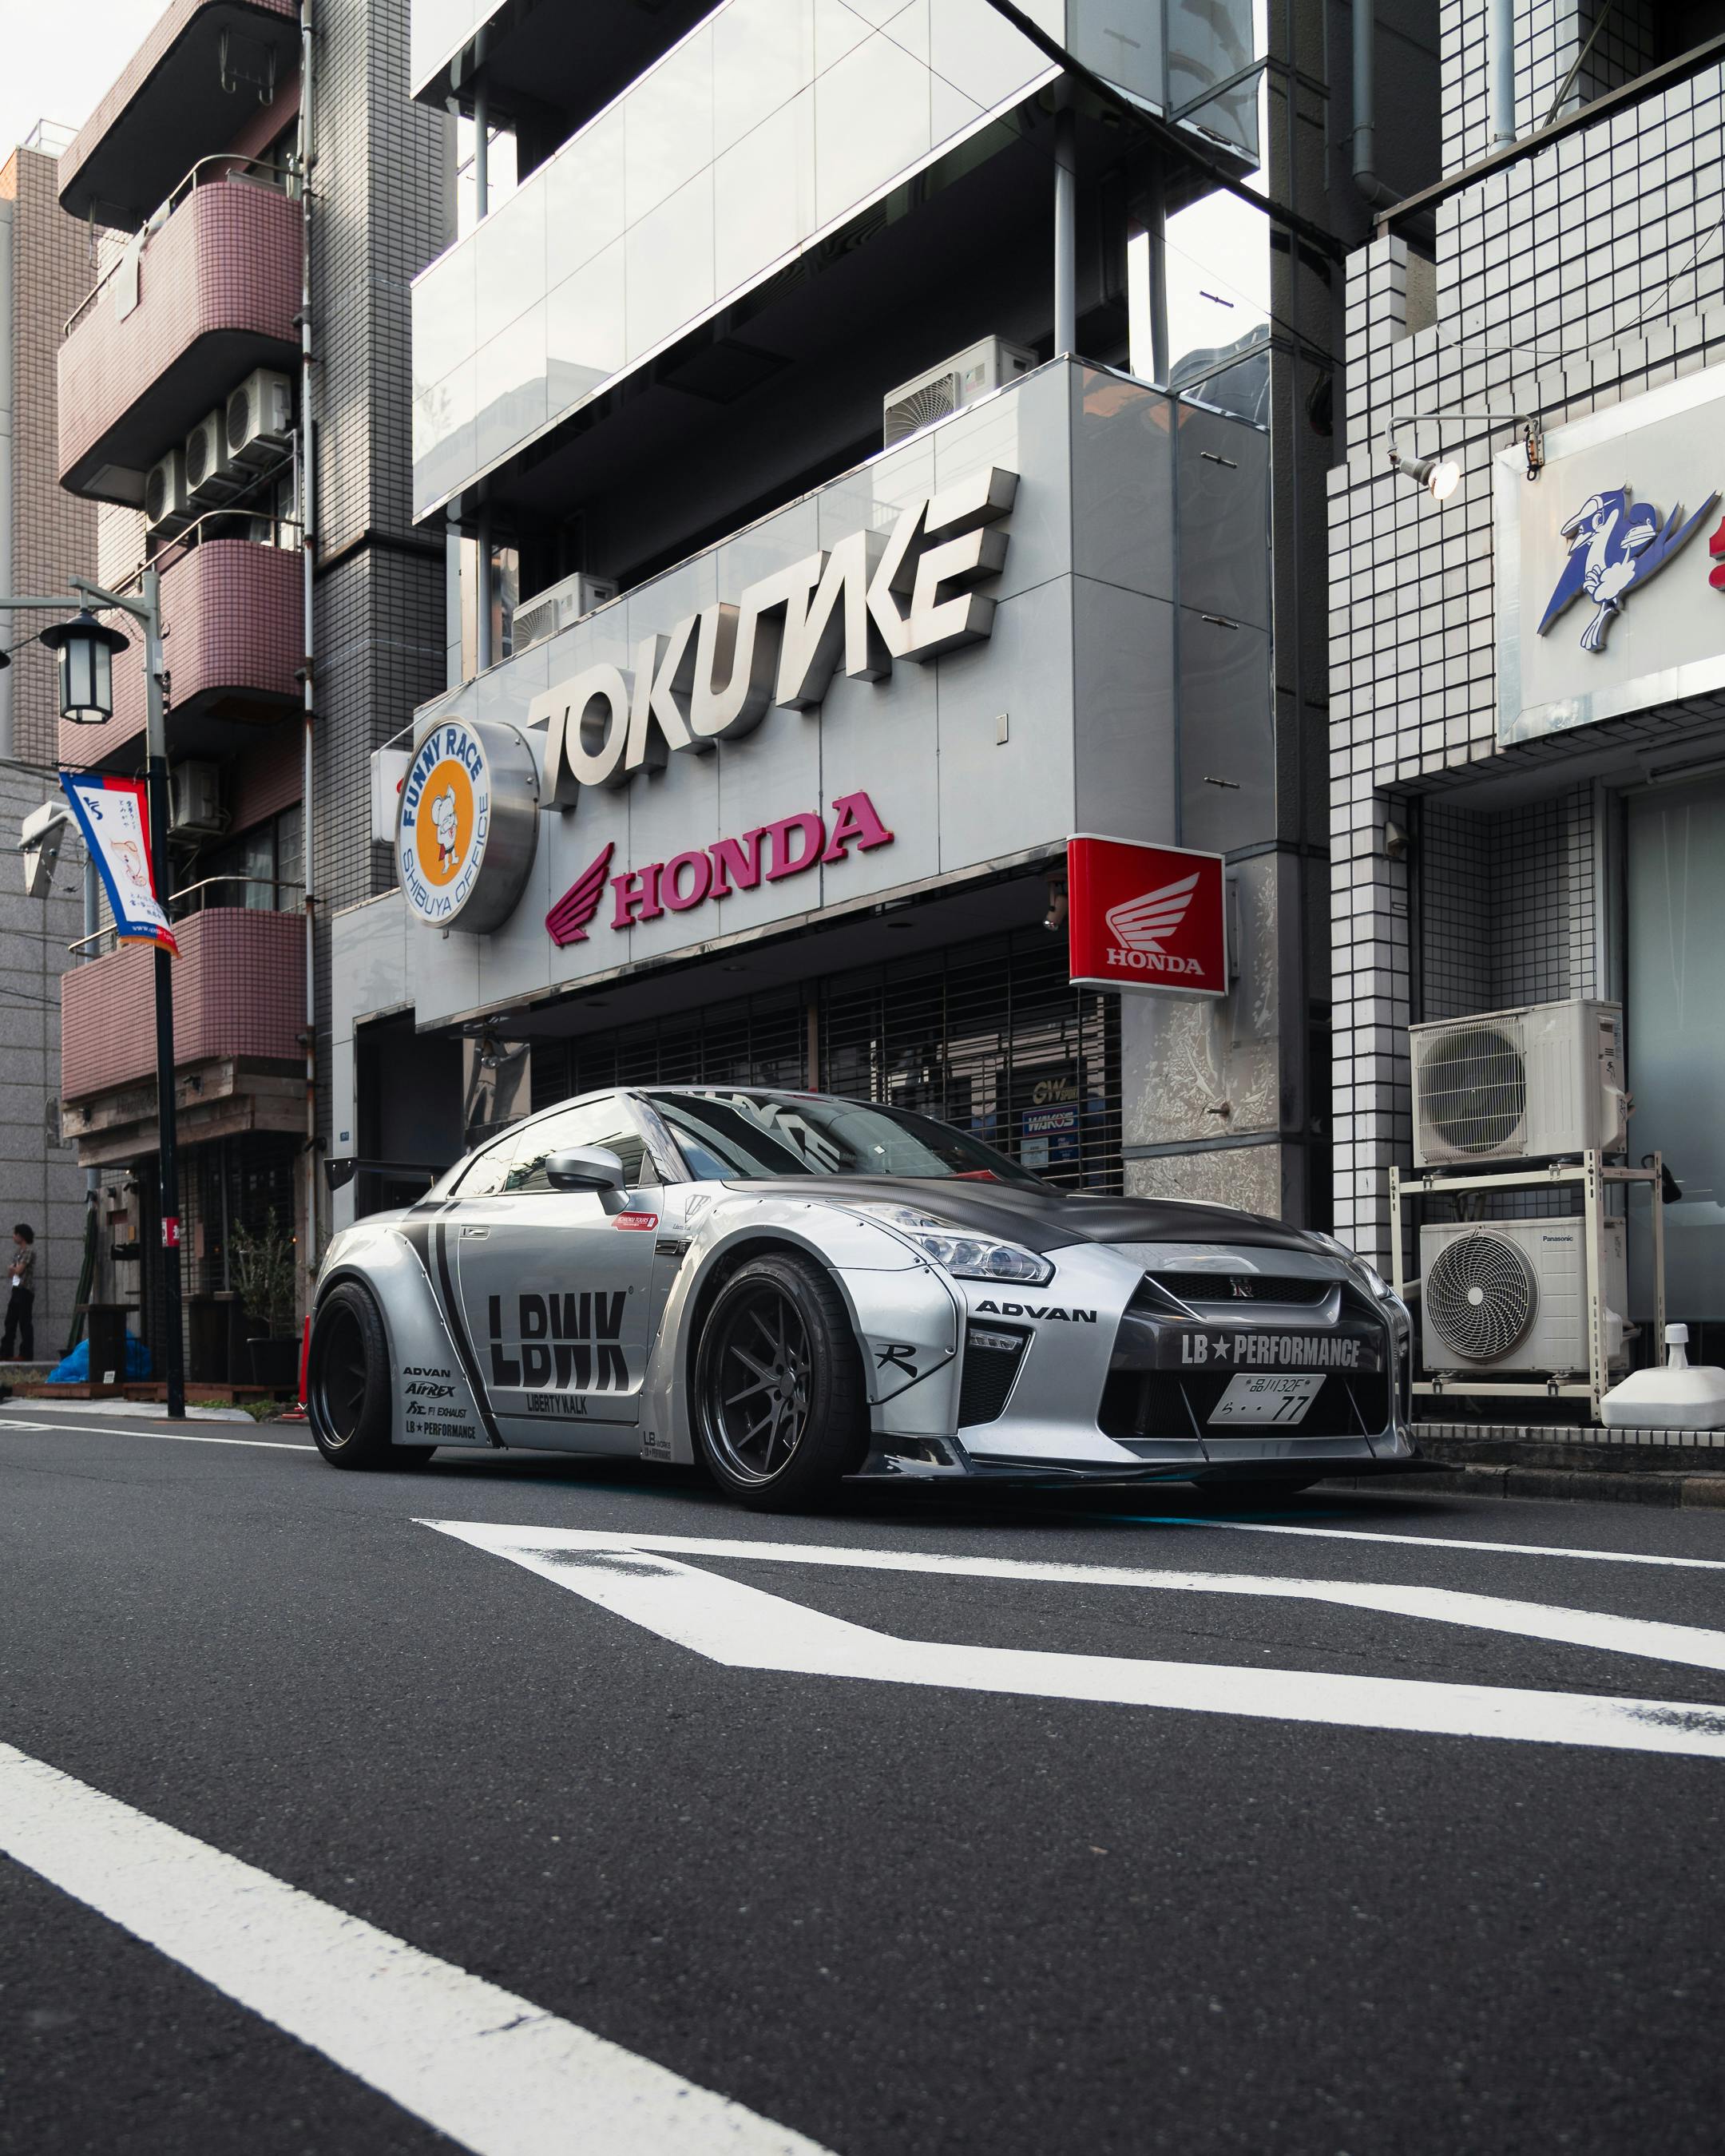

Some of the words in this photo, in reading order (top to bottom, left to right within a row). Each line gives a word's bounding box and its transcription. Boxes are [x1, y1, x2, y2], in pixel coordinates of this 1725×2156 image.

[403, 734, 442, 827] FUNNY
[446, 728, 483, 783] RACE
[403, 848, 452, 917] SHIBUYA
[455, 792, 488, 903] OFFICE
[610, 791, 894, 929] HONDA
[1106, 948, 1205, 975] HONDA
[975, 1300, 1097, 1323] ADVAN
[1182, 1334, 1208, 1364] LB
[1233, 1334, 1361, 1368] PERFORMANCE
[402, 1367, 450, 1377] ADVAN
[437, 1407, 467, 1418] EXHAUST
[526, 1393, 560, 1413] LIBERTY
[406, 1420, 415, 1433] LB
[424, 1421, 476, 1440] PERFORMANCE
[643, 1431, 655, 1446] LB
